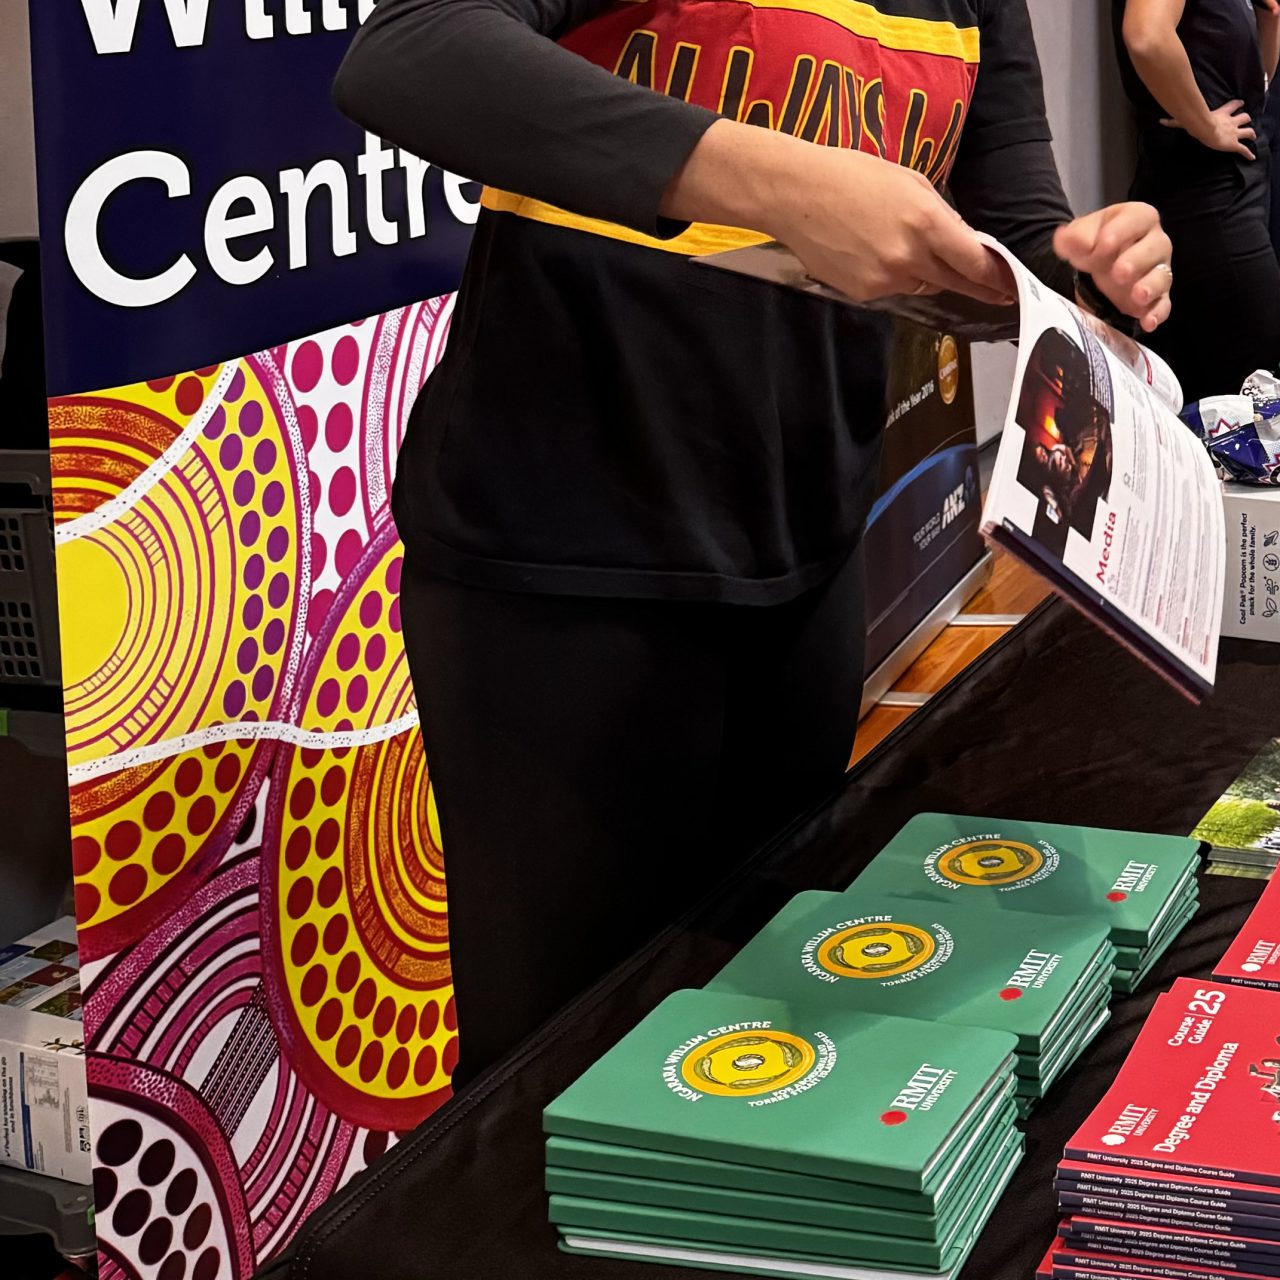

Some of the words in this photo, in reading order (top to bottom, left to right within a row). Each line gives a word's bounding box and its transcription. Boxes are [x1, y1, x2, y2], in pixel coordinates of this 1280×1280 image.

[1095, 509, 1117, 586] Media
[1112, 860, 1149, 892] RMIT
[836, 915, 892, 929] CENTRE
[1007, 949, 1051, 988] RMIT
[1031, 954, 1063, 989] UNIVERSITY
[1188, 989, 1226, 1015] 25
[1168, 1016, 1196, 1047] Course
[1188, 1018, 1213, 1045] Guide
[663, 1065, 703, 1102] NGARARA
[707, 1021, 772, 1037] CENTRE
[1195, 1042, 1239, 1090] Diploma
[890, 1063, 944, 1110] RMIT
[919, 1069, 958, 1111] UNIVERSITY
[1186, 1091, 1212, 1114] and
[1109, 1103, 1148, 1135] RMIT
[1153, 1114, 1196, 1153] Degree
[1087, 1152, 1102, 1160] RMIT
[1102, 1154, 1128, 1165] University
[1144, 1160, 1163, 1169] Degree
[1175, 1164, 1198, 1174] Diploma
[1198, 1168, 1217, 1176] Course
